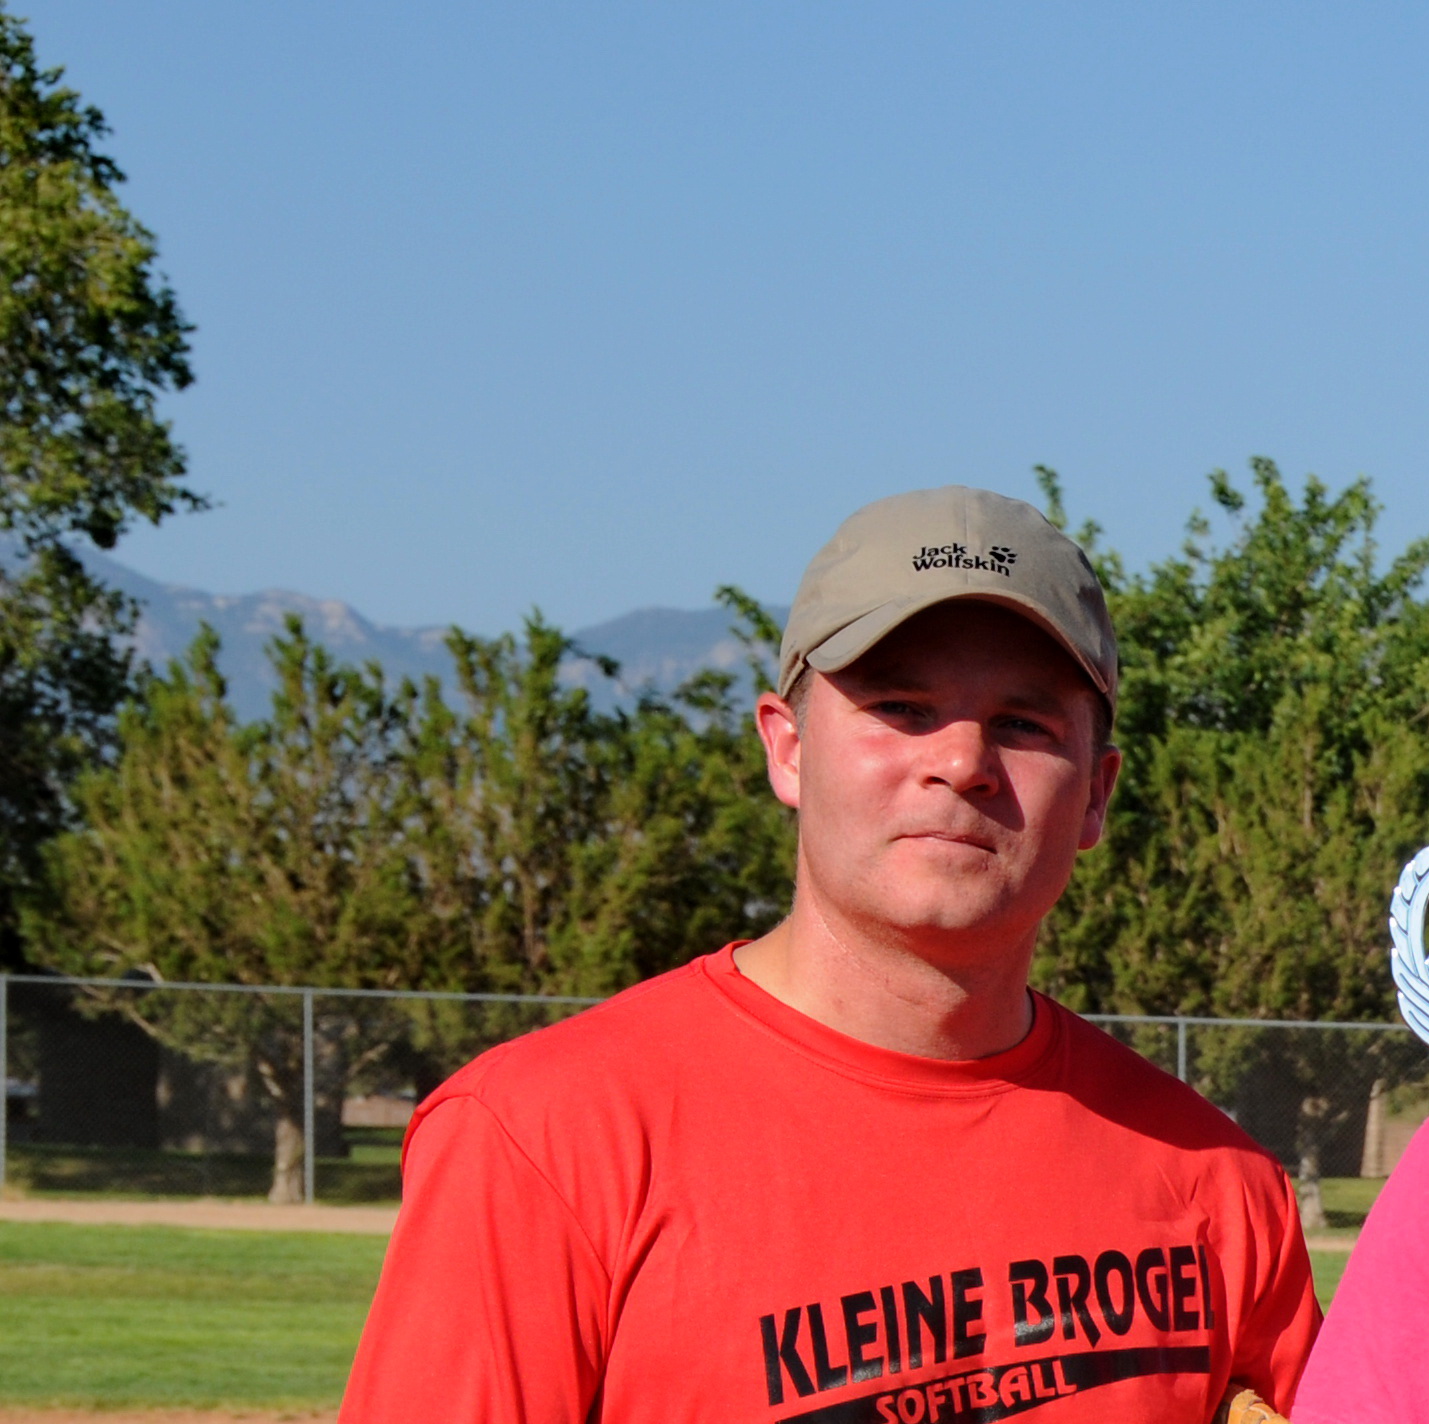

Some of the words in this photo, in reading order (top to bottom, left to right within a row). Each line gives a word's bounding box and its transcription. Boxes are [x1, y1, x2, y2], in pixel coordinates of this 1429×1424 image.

[912, 542, 967, 560] Jack
[911, 554, 1011, 577] Wolfskin
[759, 1266, 987, 1407] KLEINE
